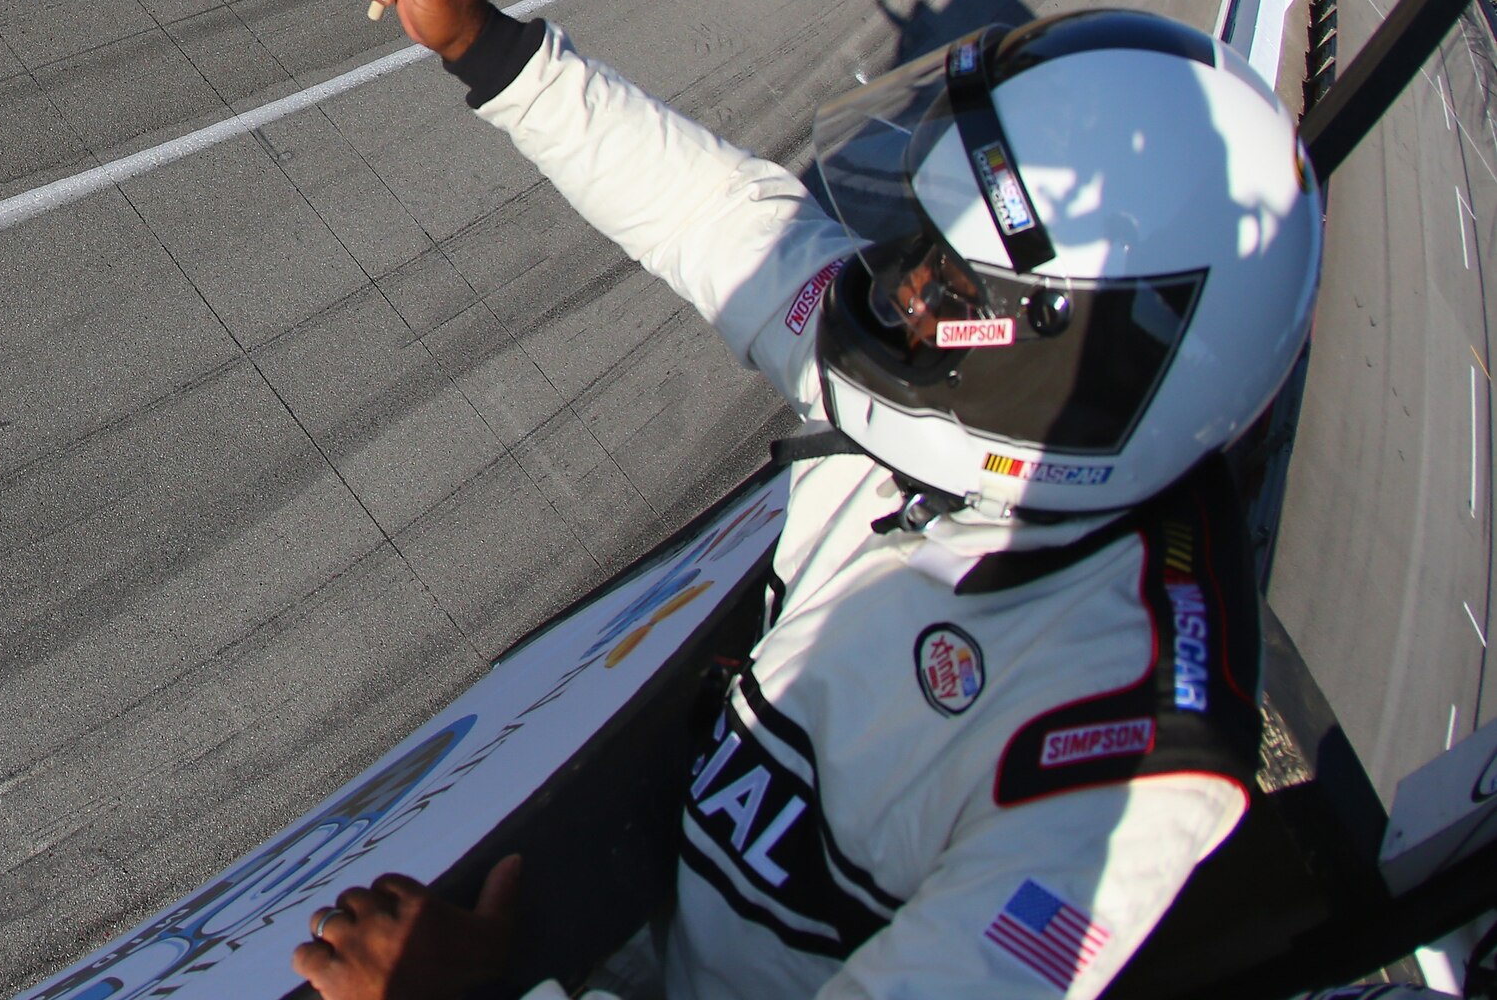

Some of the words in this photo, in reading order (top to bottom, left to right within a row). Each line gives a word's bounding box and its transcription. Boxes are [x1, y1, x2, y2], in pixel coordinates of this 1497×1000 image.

[942, 324, 1006, 343] SIMPSON
[1023, 461, 1114, 485] NASCAR
[1166, 582, 1208, 712] NASCAR
[1046, 722, 1149, 762] SIMPSON
[142, 650, 607, 1000] NATIONWI
[691, 708, 807, 888] IAL
